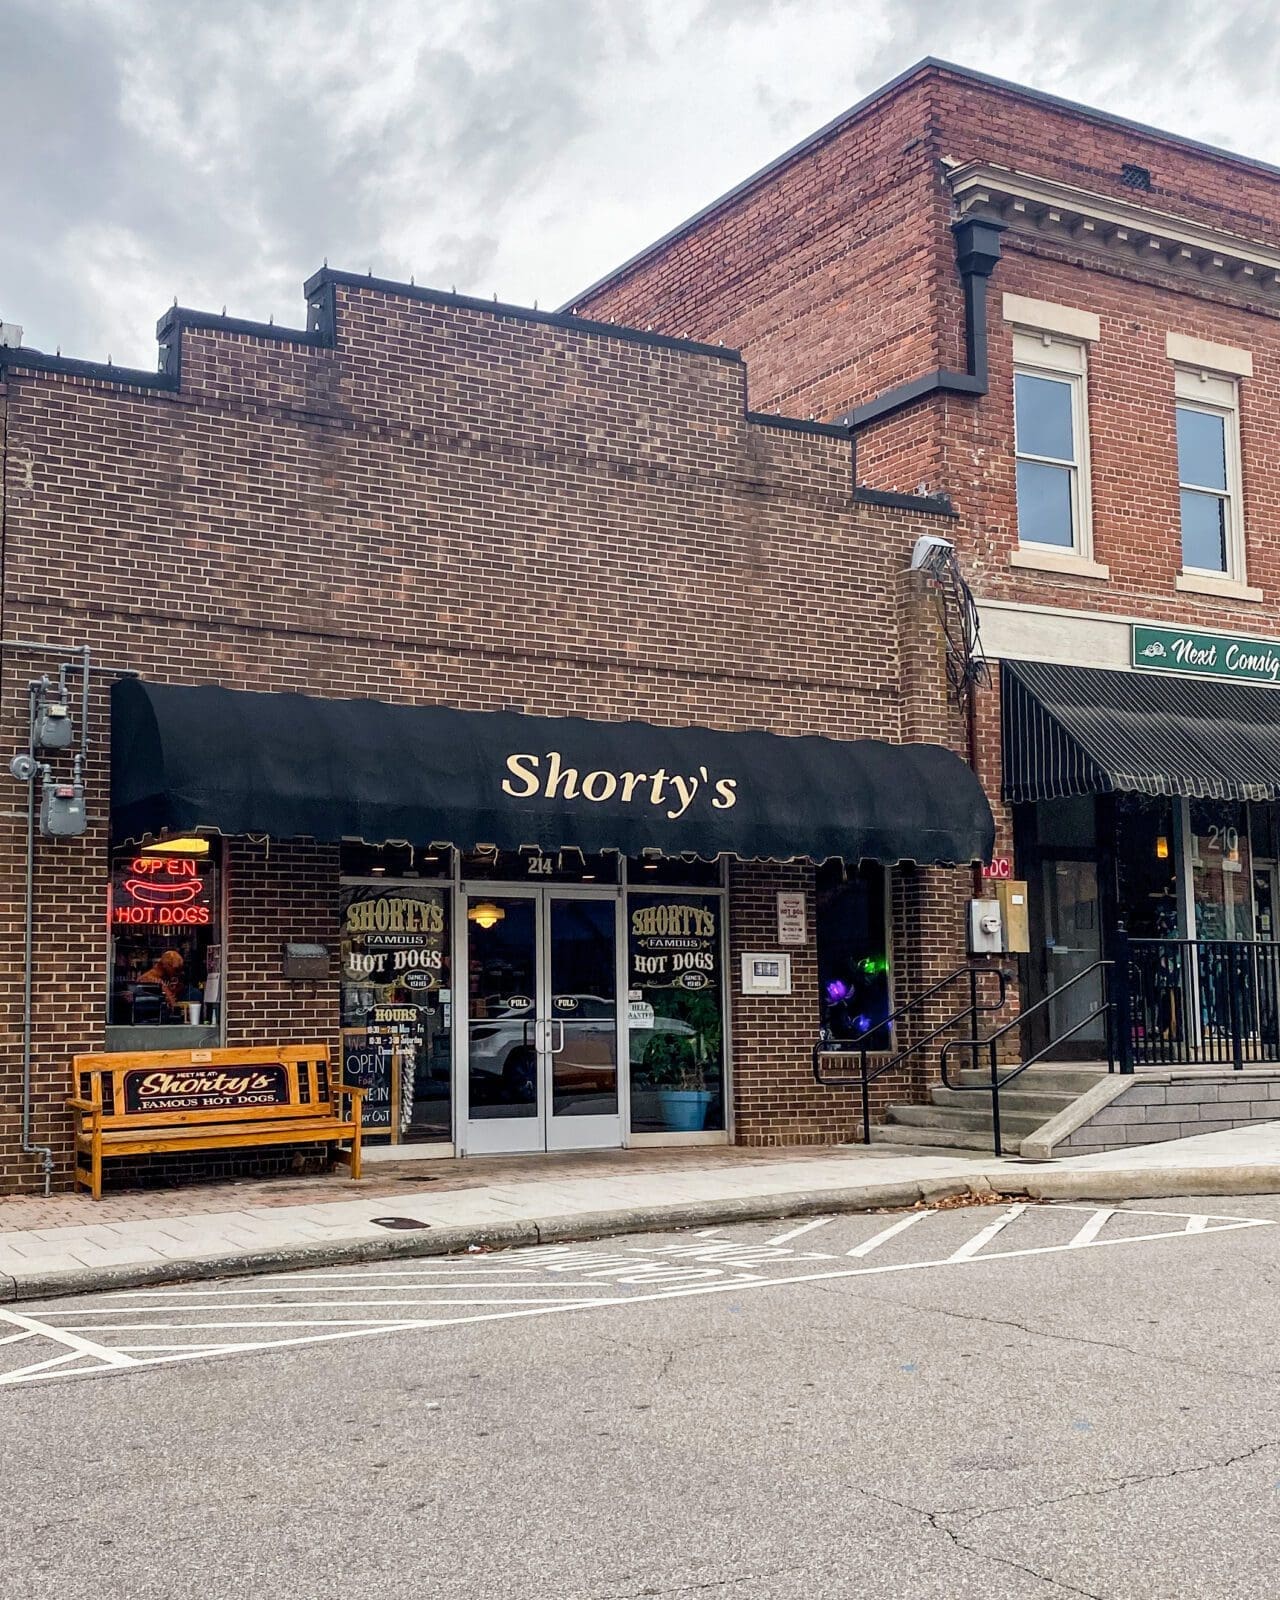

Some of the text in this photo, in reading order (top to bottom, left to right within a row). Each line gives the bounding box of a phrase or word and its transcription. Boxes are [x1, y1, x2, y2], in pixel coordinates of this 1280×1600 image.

[1171, 638, 1280, 681] Next Consig
[501, 751, 737, 819] Shorty's
[1207, 824, 1238, 851] 210
[133, 858, 196, 876] OPEN
[528, 857, 553, 874] 214
[160, 907, 210, 923] DOGS
[346, 898, 444, 933] SHORTY'S
[632, 904, 715, 937] SHORTY'S
[367, 935, 424, 944] FAMOUS
[649, 939, 698, 947] FAMOUS
[349, 949, 442, 973] HOT DOGS
[634, 952, 714, 974] HOT DOGS
[510, 999, 528, 1007] PULL
[558, 999, 575, 1007] PULL
[632, 1003, 650, 1012] HELP
[375, 1008, 417, 1022] HOURS
[346, 1054, 385, 1074] OPEN
[138, 1071, 276, 1095] Shorty's
[142, 1094, 274, 1109] FAMOUS HOT DOGS
[377, 1087, 389, 1102] IN
